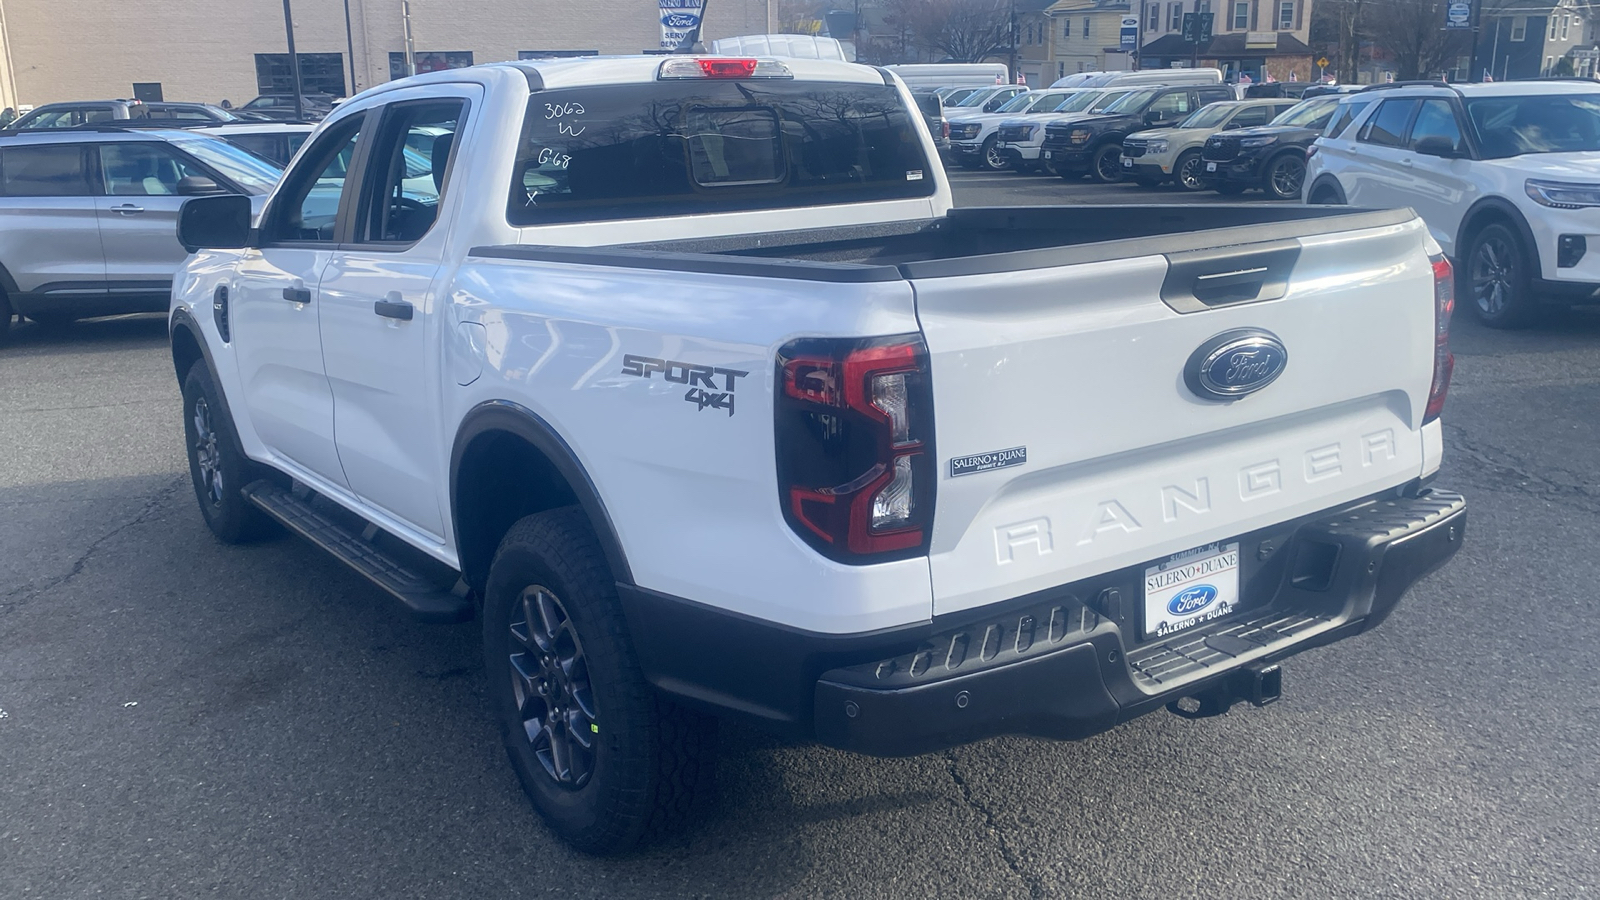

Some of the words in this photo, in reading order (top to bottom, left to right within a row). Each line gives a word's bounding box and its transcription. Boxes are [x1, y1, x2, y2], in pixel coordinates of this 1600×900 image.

[668, 15, 694, 26] Ford
[544, 102, 585, 120] 3062
[525, 190, 538, 207] X
[621, 353, 750, 393] SPORT
[1225, 350, 1271, 384] Ford
[953, 454, 991, 469] SALERNO
[998, 448, 1026, 462] DUANE
[992, 426, 1398, 566] RANGER
[1147, 566, 1196, 591] SALERNO
[1200, 553, 1237, 575] DUANE
[1177, 588, 1208, 613] Ford
[1157, 617, 1196, 638] SALERNO
[1206, 605, 1233, 621] DUANE
